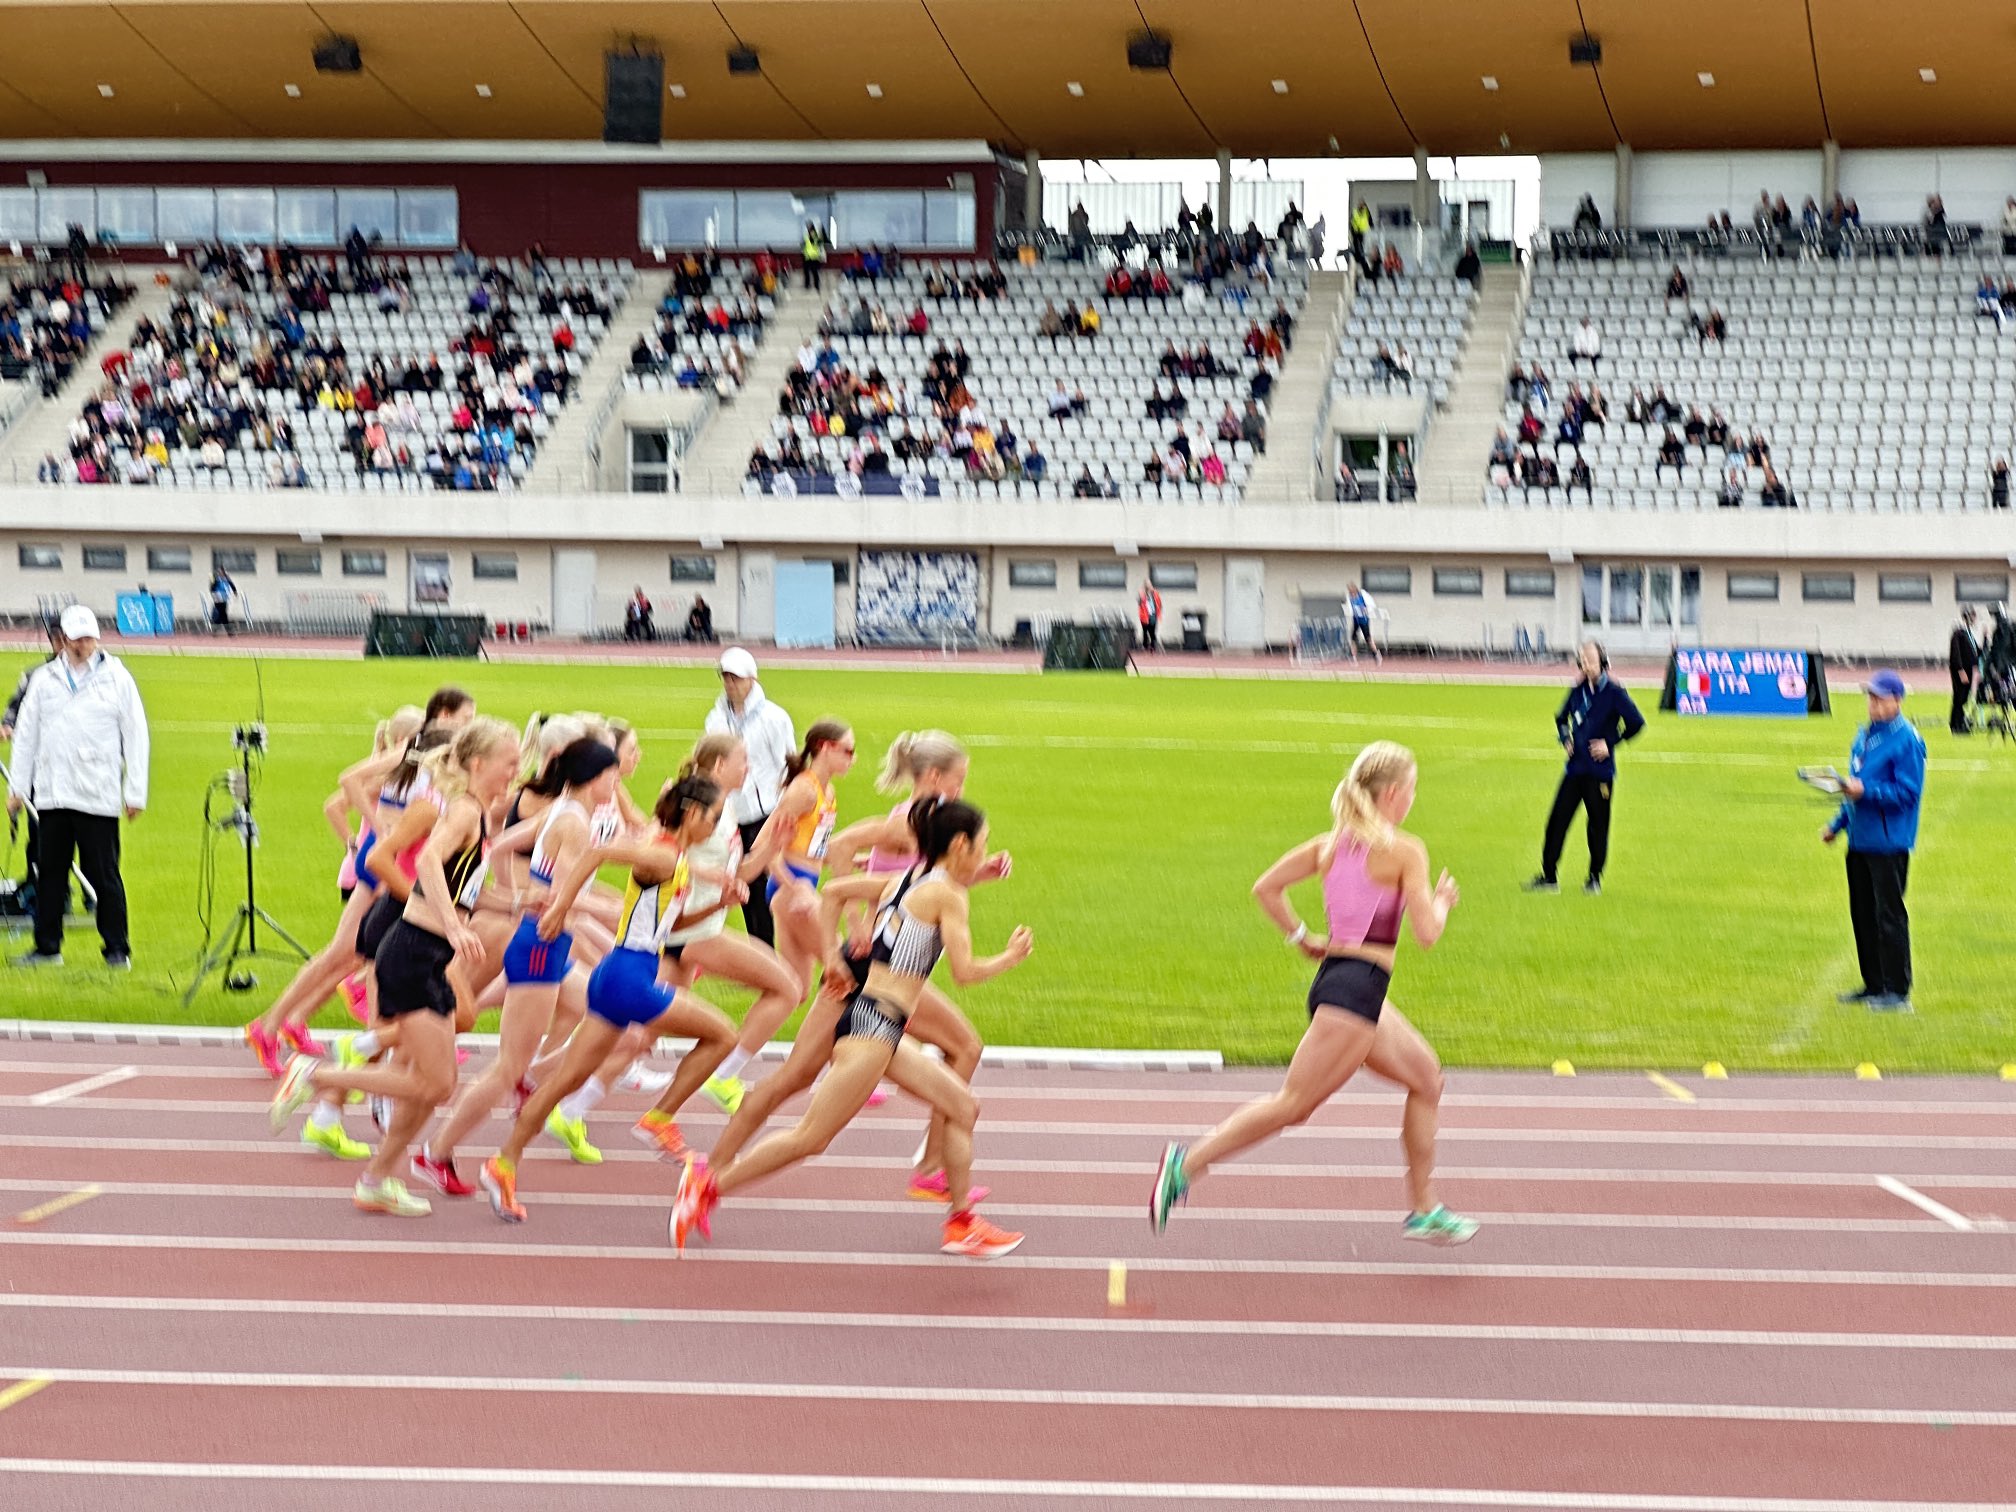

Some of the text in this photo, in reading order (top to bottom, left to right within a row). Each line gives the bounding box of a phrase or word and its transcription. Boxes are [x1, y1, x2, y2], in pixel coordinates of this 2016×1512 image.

[1677, 651, 1804, 675] SARA JEMAI
[1718, 673, 1751, 695] ITA
